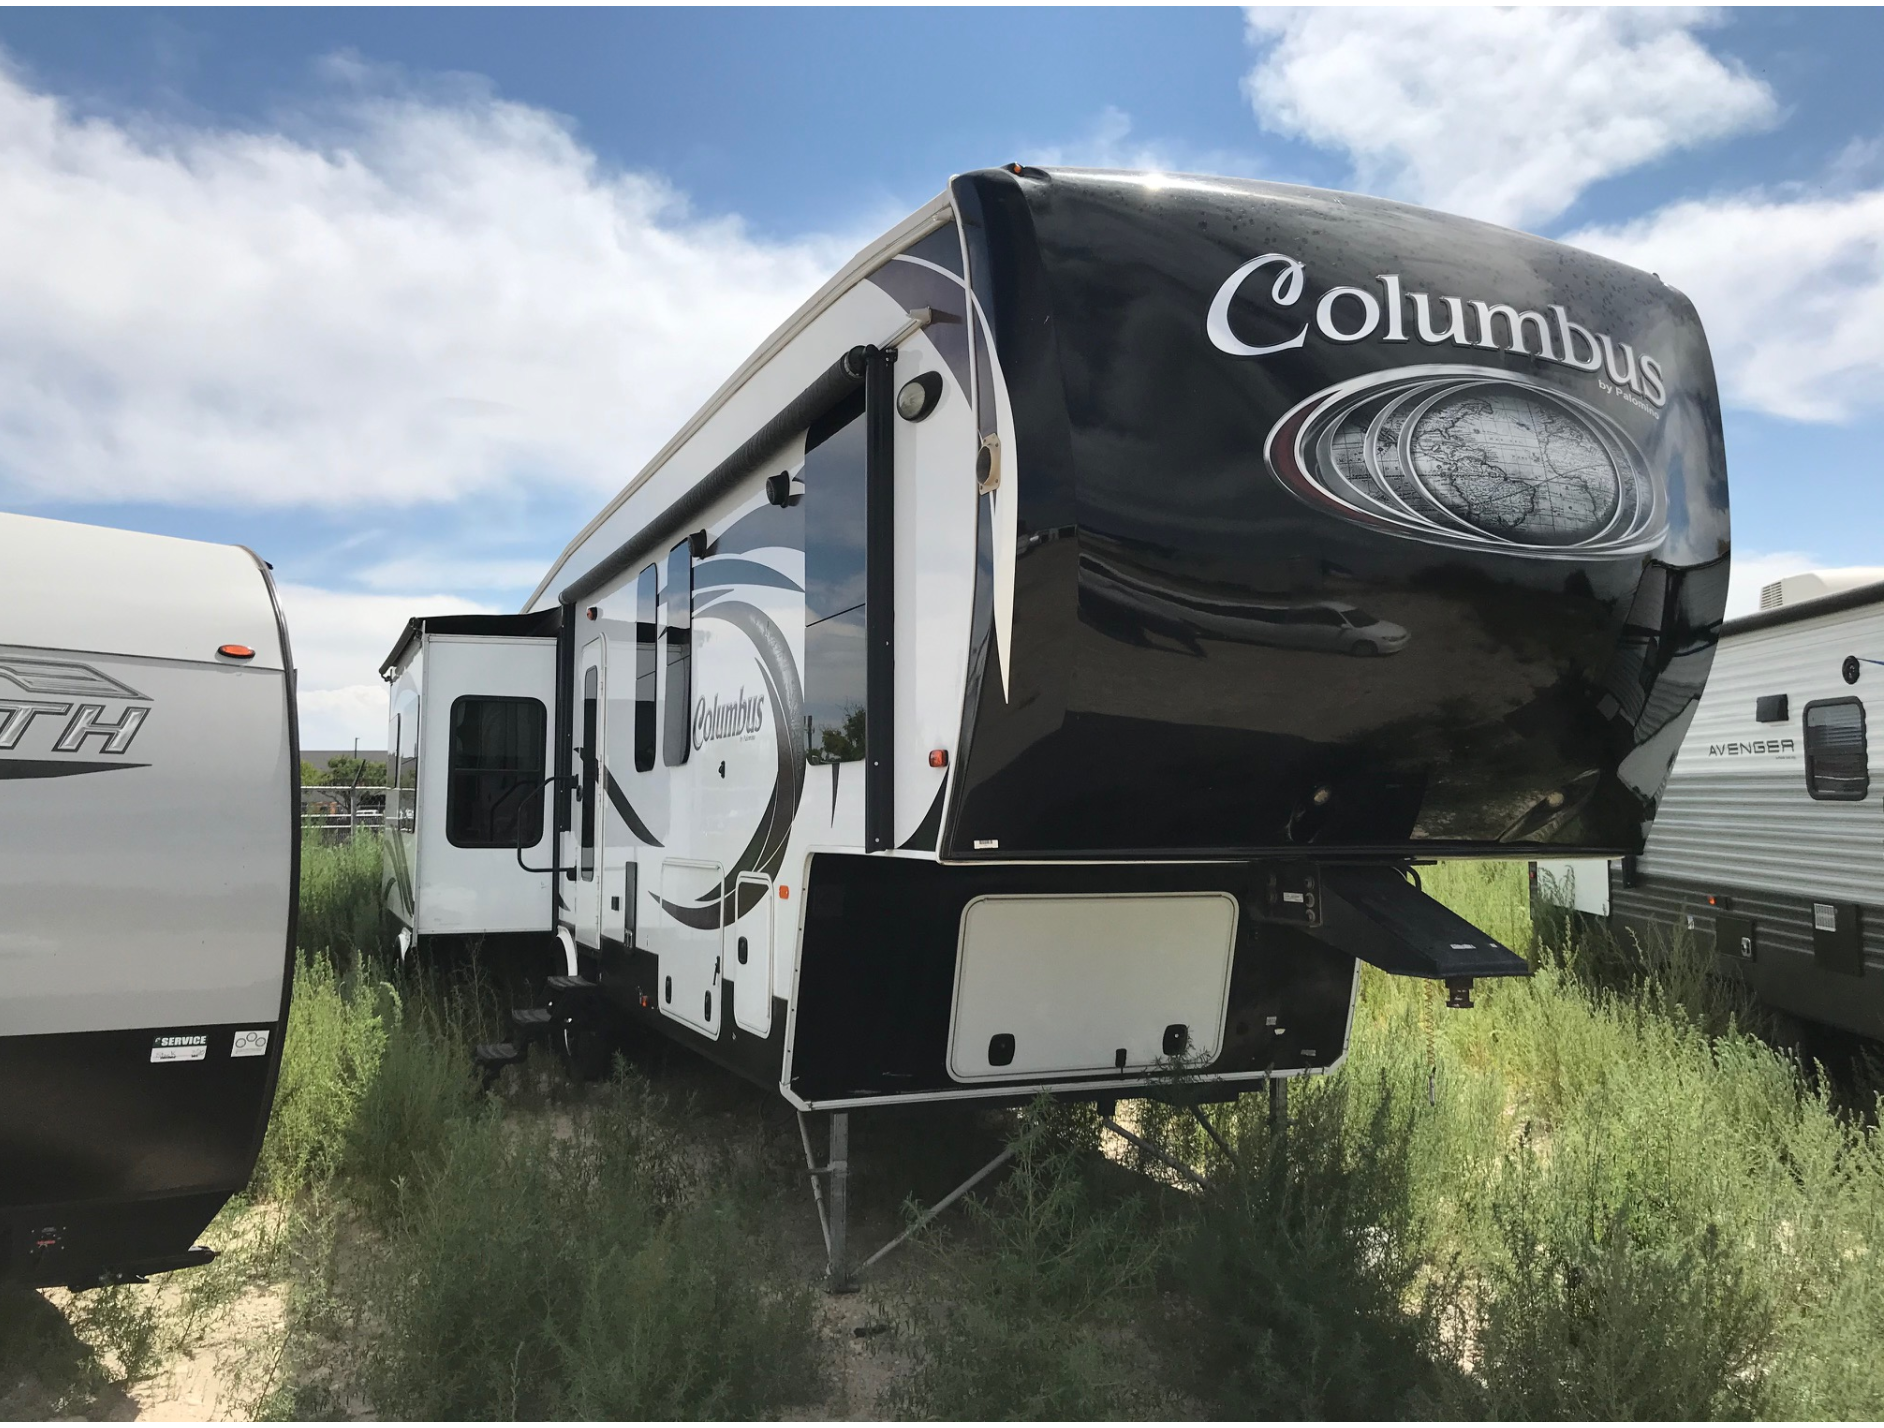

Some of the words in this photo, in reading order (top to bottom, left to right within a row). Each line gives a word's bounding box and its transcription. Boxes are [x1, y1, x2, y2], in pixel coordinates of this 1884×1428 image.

[1206, 252, 1667, 408] Columbus
[1598, 379, 1612, 394] by
[1615, 386, 1660, 420] Palomino
[692, 684, 764, 751] Columbus
[1708, 738, 1794, 757] AVENGER
[161, 1035, 207, 1047] SERVICE
